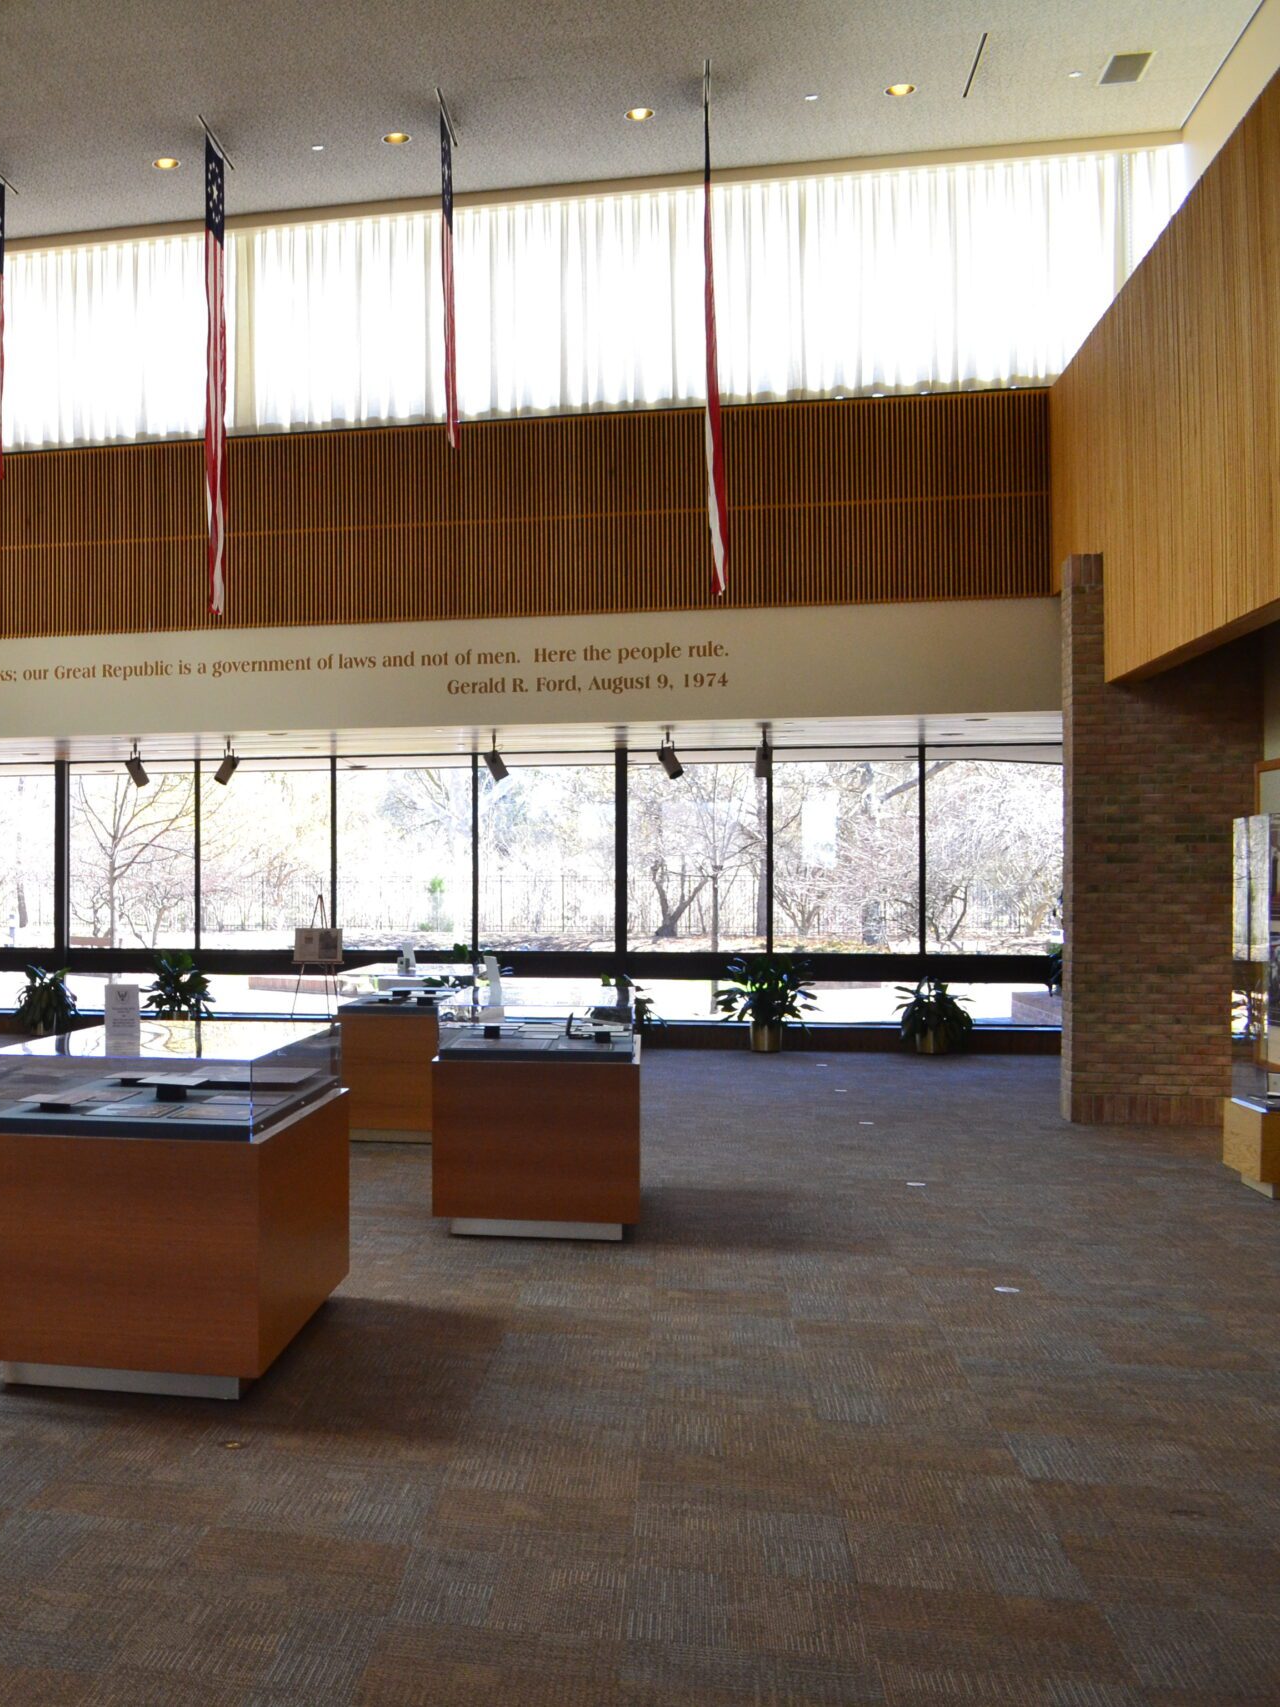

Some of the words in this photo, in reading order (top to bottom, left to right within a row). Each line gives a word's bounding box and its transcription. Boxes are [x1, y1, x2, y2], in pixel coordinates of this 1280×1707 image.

[22, 668, 50, 681] our
[53, 664, 97, 681] Great
[101, 659, 174, 682] Republic
[178, 659, 192, 676] is
[196, 662, 208, 675] a
[211, 656, 312, 679] government
[316, 653, 334, 671] of
[338, 653, 377, 670] laws
[381, 650, 416, 669] and
[420, 650, 449, 667] not
[454, 648, 473, 666] of
[476, 650, 521, 665] men.
[533, 647, 577, 664] Here
[582, 644, 612, 662] the
[616, 641, 682, 665] people
[687, 640, 729, 659] rule.
[446, 676, 507, 696] Gerald
[511, 677, 529, 693] R.
[535, 674, 582, 694] Ford,
[587, 673, 651, 695] August
[656, 673, 674, 691] 9,
[683, 671, 729, 689] 1974
